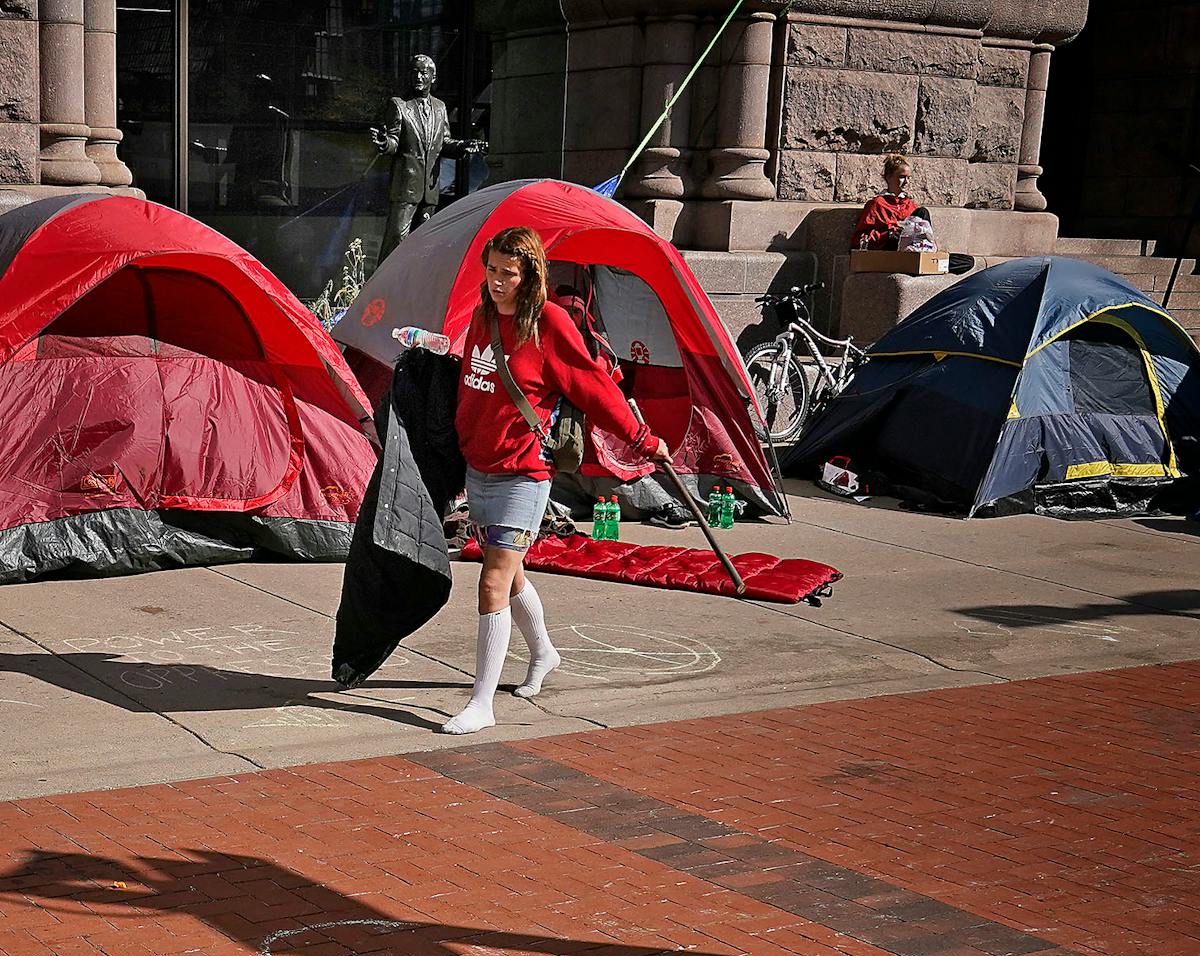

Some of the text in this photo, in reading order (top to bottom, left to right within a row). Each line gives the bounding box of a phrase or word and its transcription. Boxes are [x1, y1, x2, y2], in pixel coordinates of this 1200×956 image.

[464, 372, 496, 394] adidas
[62, 623, 300, 652] POWER
[184, 639, 302, 656] THE
